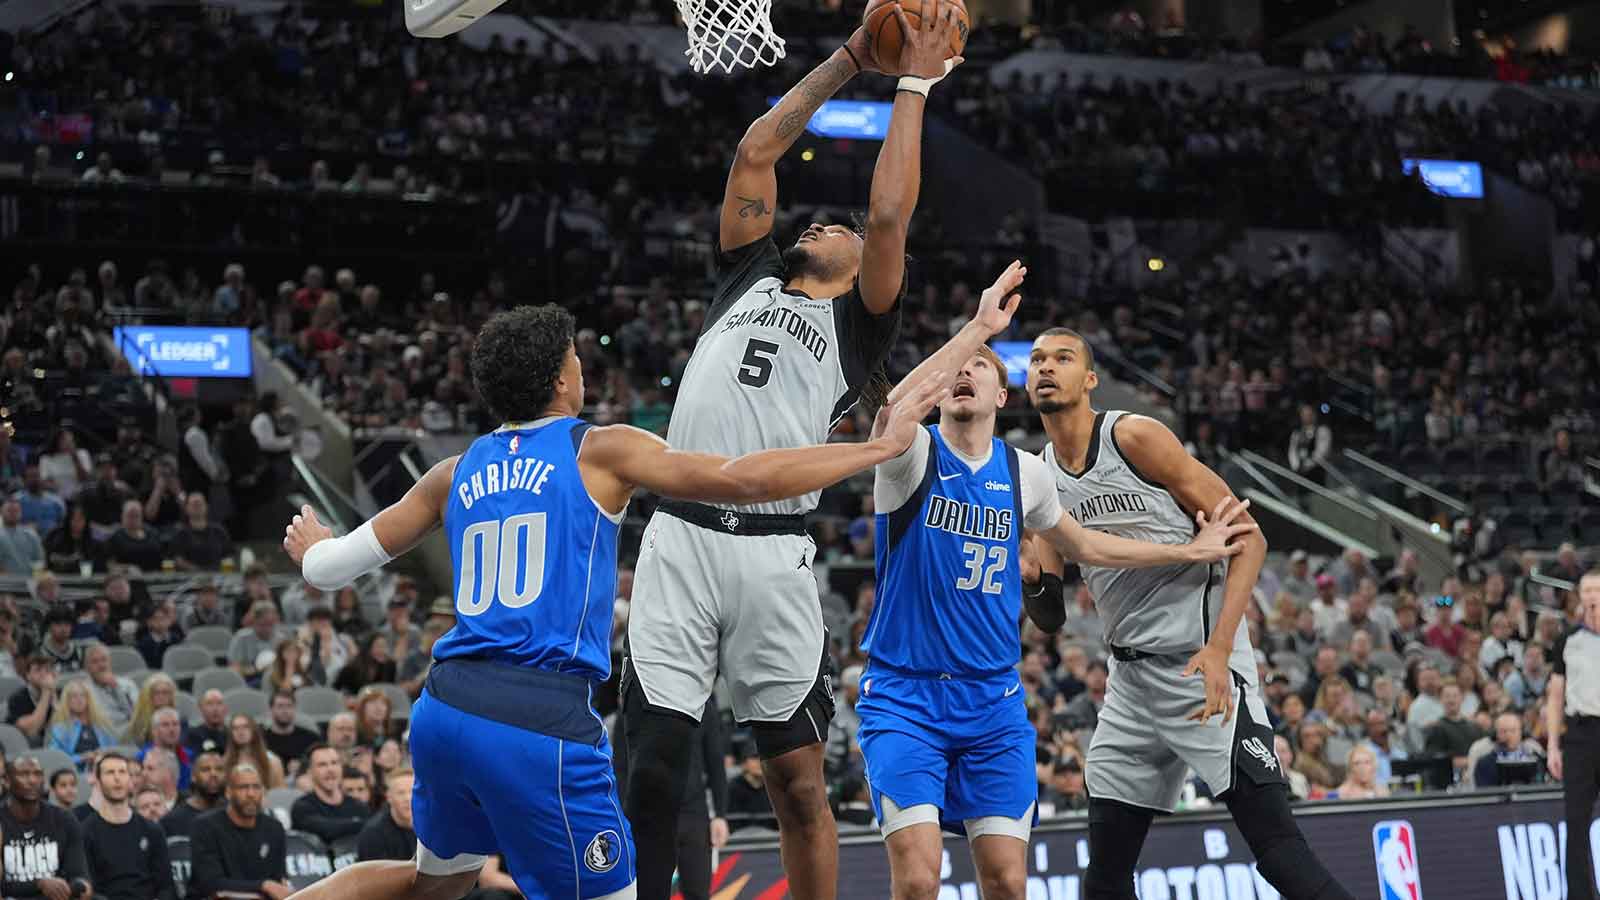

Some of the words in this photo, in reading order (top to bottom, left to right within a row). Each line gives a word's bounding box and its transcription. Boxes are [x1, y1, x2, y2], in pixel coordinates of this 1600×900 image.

[721, 307, 759, 334] SAN
[752, 307, 828, 363] ANTONIO
[736, 336, 780, 389] 5
[458, 457, 555, 510] CHRISTIE
[985, 480, 1011, 492] chime
[1080, 493, 1147, 522] ANTONIO
[925, 494, 1012, 541] DALLAS
[456, 511, 547, 617] 00
[956, 541, 1008, 594] 32
[1497, 820, 1568, 900] NB
